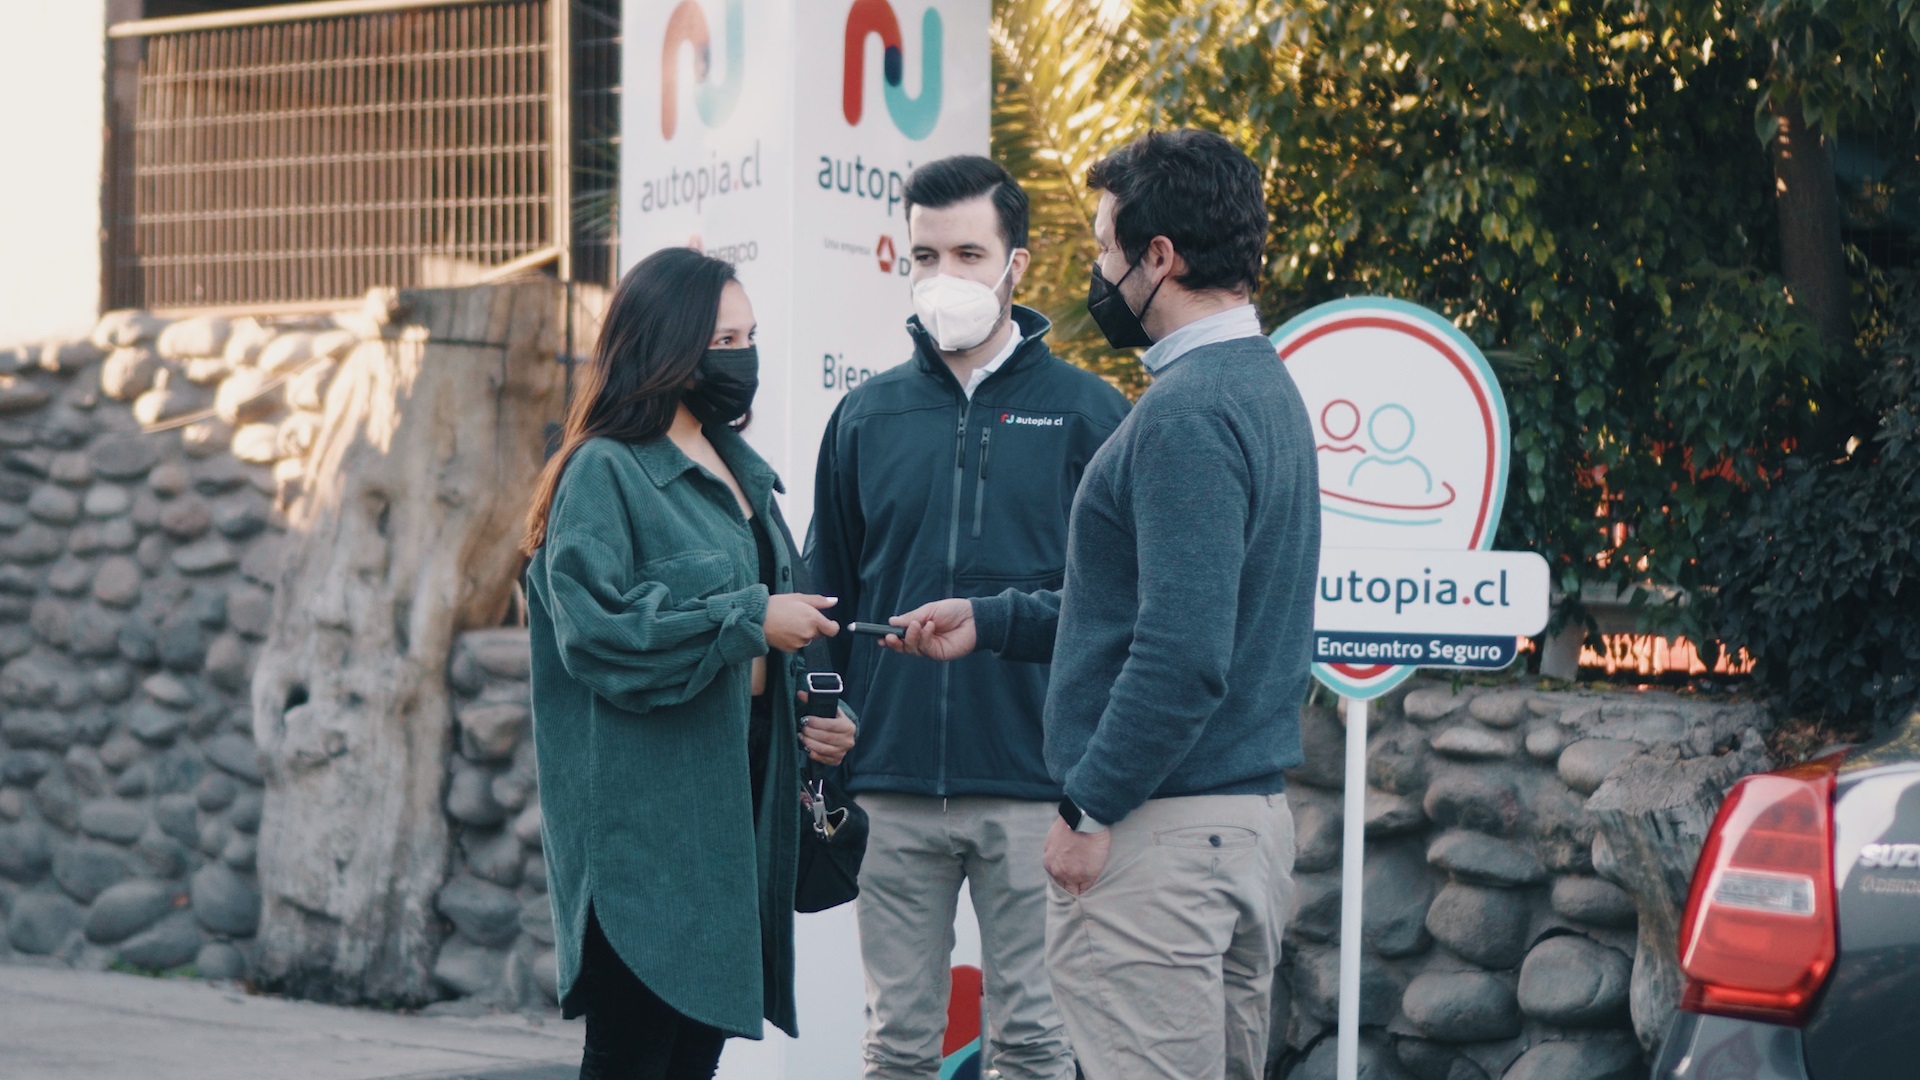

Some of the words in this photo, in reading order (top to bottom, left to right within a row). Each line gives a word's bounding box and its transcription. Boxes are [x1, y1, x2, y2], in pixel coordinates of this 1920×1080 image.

[641, 139, 762, 213] autopia.cl
[818, 155, 911, 217] autop
[824, 353, 877, 391] Bien
[1320, 567, 1510, 615] utopia.cl
[1317, 636, 1423, 659] Encuentro
[1429, 639, 1502, 664] Seguro
[1860, 844, 1920, 868] SUZ
